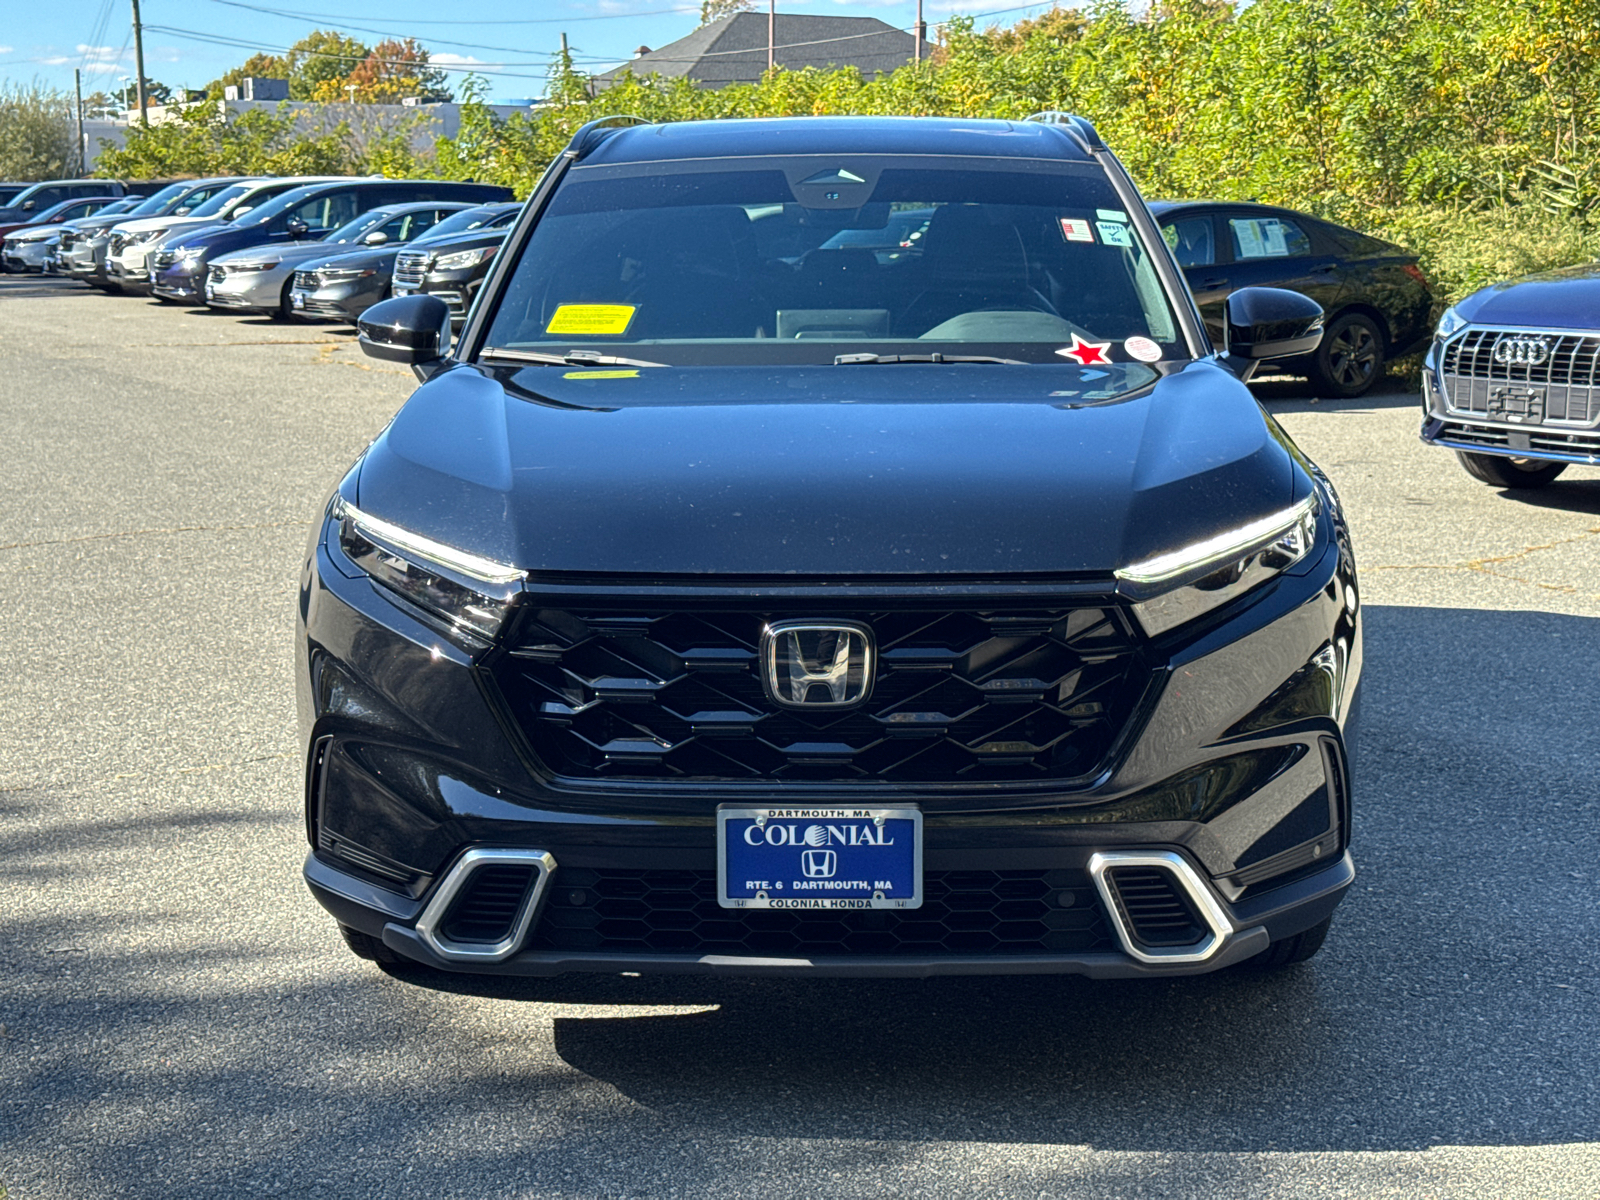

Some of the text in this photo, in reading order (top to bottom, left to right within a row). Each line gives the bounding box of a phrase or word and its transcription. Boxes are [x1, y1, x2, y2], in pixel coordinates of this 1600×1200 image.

[852, 810, 871, 818] MA
[743, 824, 894, 847] COLONIAL
[745, 881, 893, 891] RTE. 6 DARTMOUTH, MA
[768, 899, 872, 909] COLONIAL HONDA
